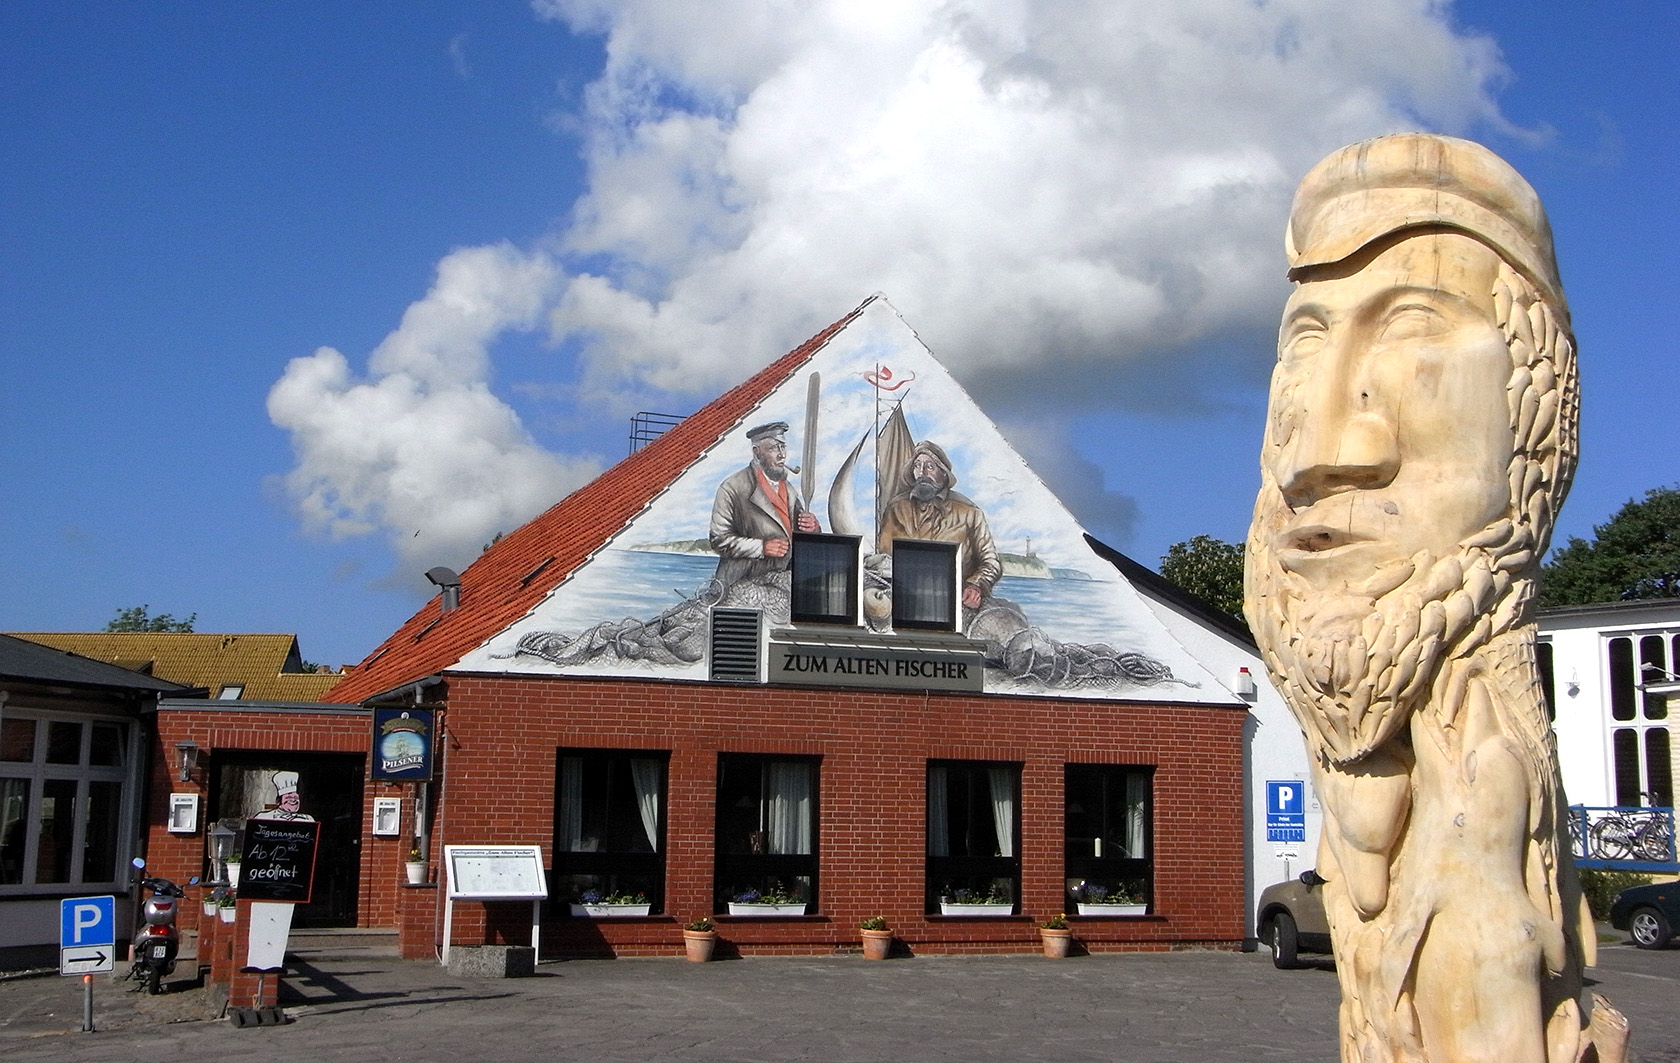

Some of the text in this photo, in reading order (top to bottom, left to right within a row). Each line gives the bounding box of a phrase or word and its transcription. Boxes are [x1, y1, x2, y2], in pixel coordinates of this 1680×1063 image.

[783, 653, 968, 680] ZUM ALTEN FISCHER
[382, 756, 423, 769] PILSENER
[1278, 786, 1293, 810] P
[248, 843, 268, 860] Ab
[74, 904, 102, 943] P
